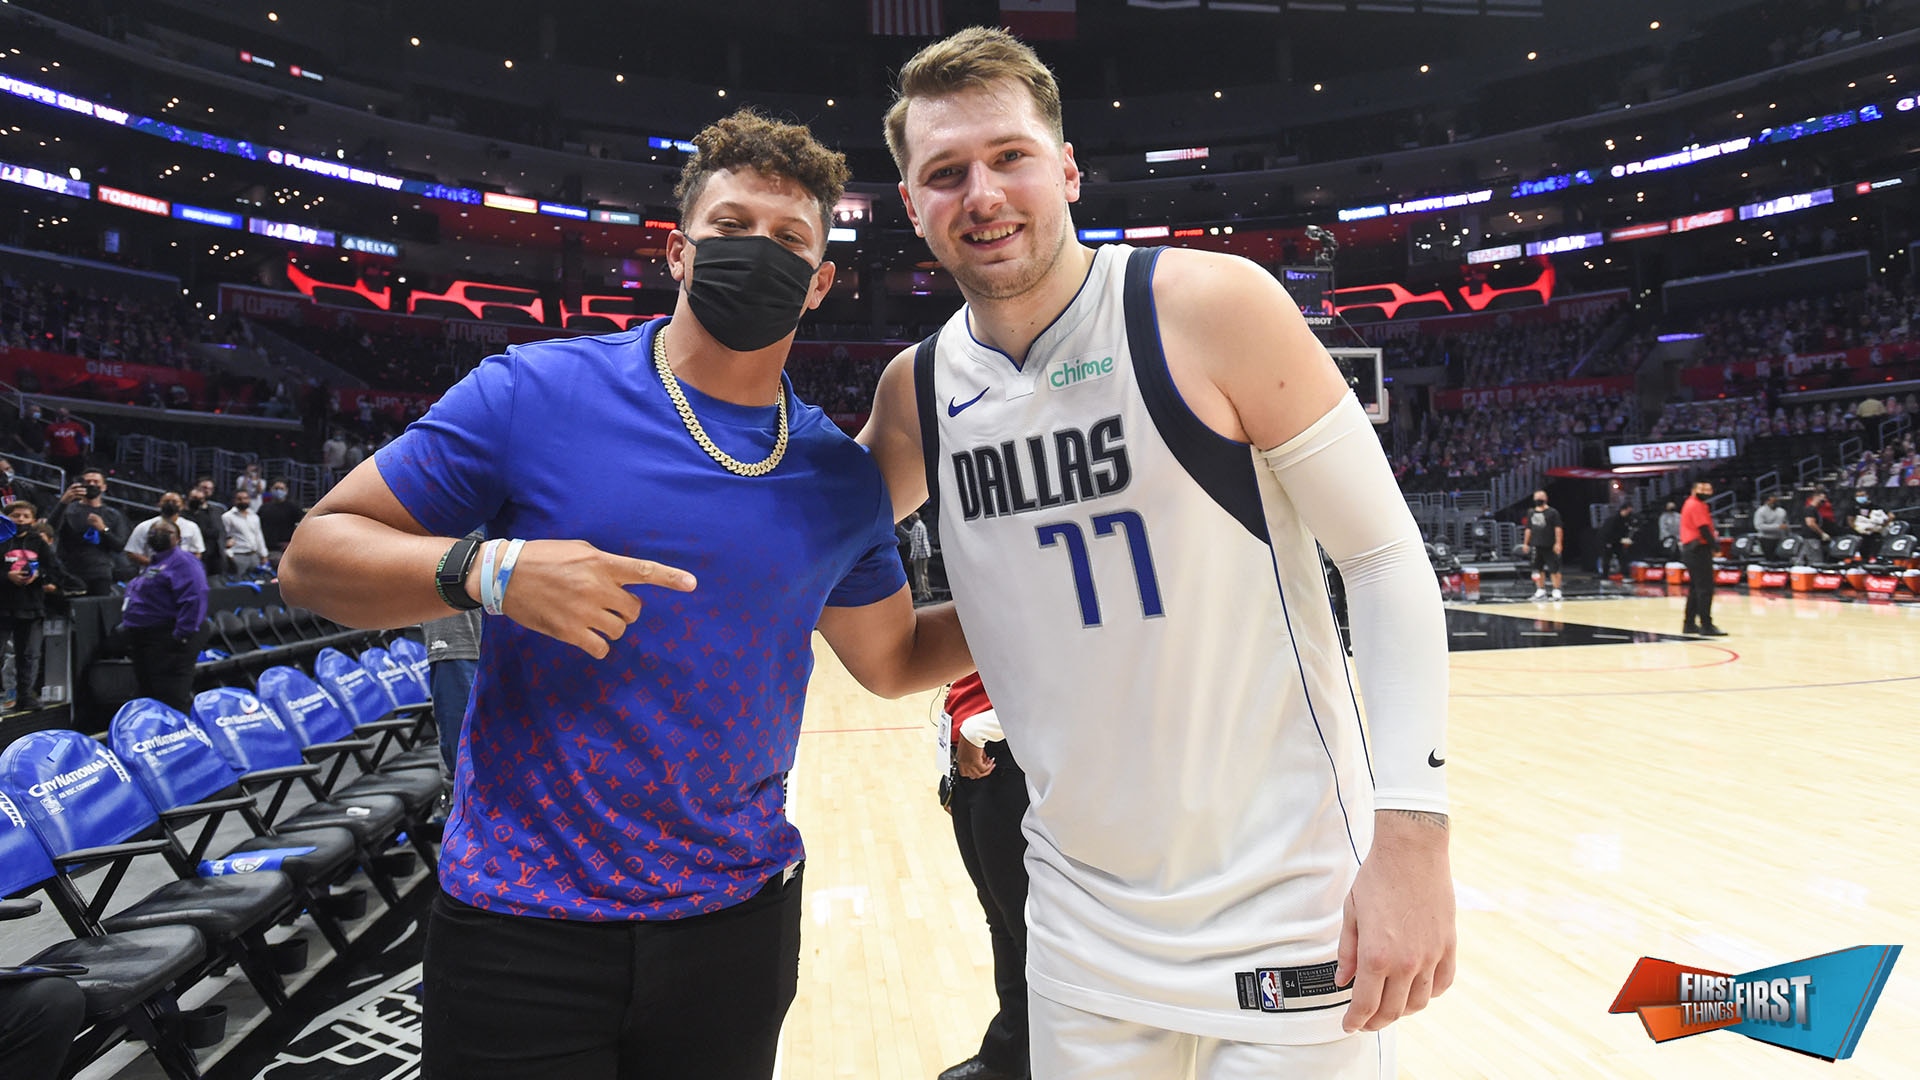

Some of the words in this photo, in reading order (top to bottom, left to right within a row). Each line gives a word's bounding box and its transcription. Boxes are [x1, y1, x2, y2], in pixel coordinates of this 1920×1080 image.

[99, 186, 169, 215] TOSHIBA
[357, 240, 396, 255] DELTA
[1470, 245, 1518, 263] STAPLES
[1304, 317, 1332, 325] ISSOT
[85, 361, 123, 377] ONE
[1051, 356, 1114, 388] chime
[1632, 443, 1709, 460] STAPLES
[952, 414, 1132, 522] DALLAS
[1035, 508, 1166, 629] 77
[1285, 980, 1295, 988] 54
